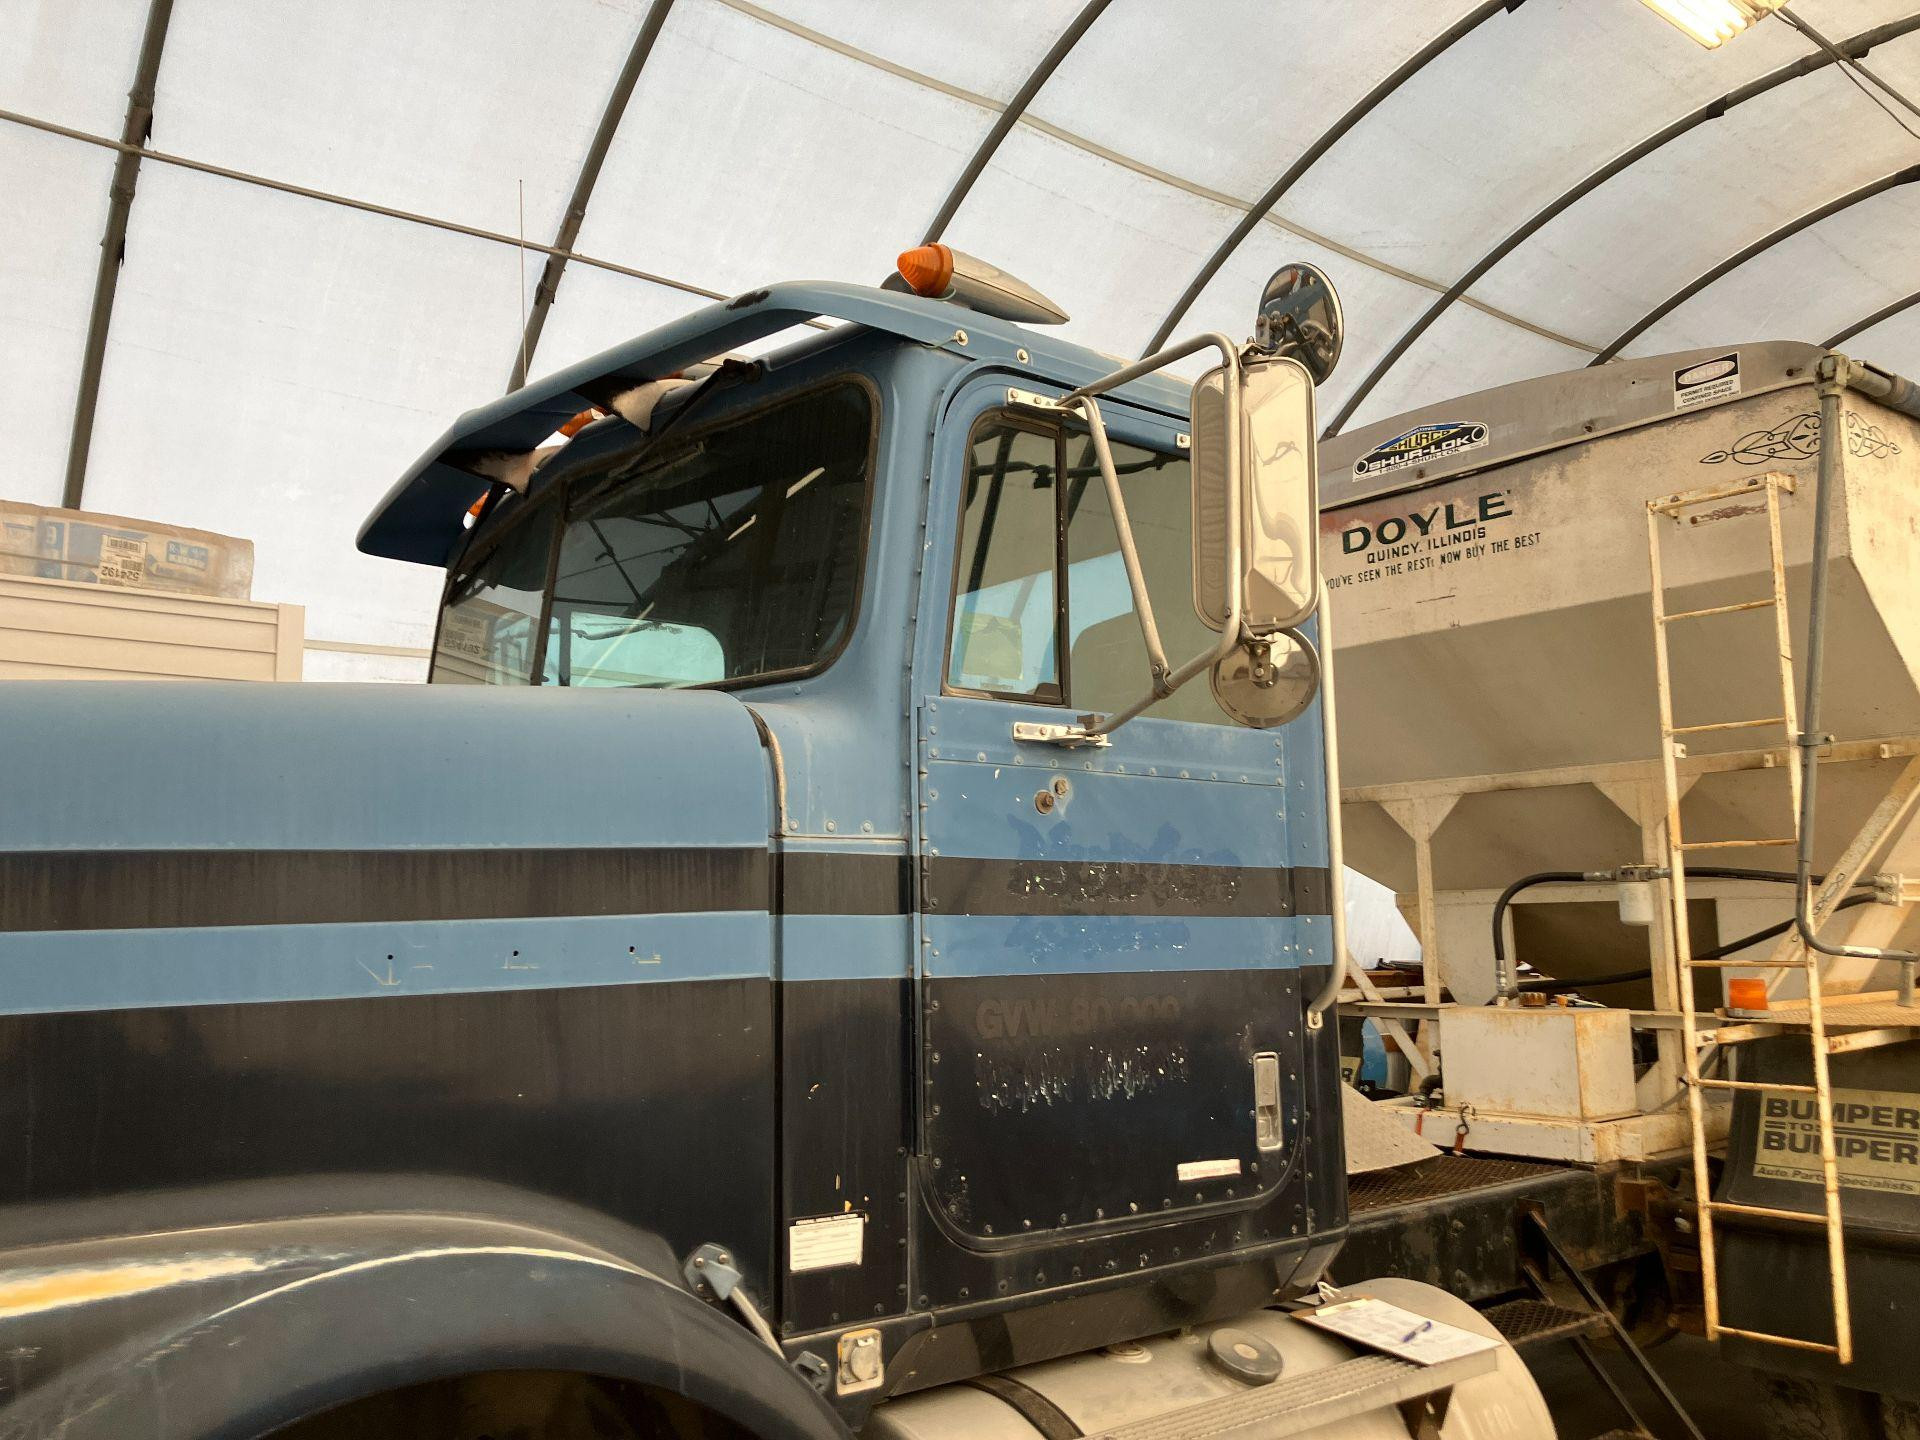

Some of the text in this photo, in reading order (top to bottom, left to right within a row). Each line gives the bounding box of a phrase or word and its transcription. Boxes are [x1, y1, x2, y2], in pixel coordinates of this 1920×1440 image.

[1684, 363, 1730, 382] DANGER
[1681, 379, 1734, 398] PERMIT REQUIRED
[1682, 386, 1733, 404] CONFINED SPACE
[1368, 434, 1471, 471] SHUR-LOK
[1342, 493, 1513, 554] DOYLE
[1428, 527, 1486, 550] ILLINOIS
[1358, 568, 1381, 583] SEEN
[1385, 563, 1402, 576] THE
[1440, 550, 1461, 565] NOW
[1466, 545, 1485, 559] BUY
[1491, 540, 1510, 553] THE
[1515, 532, 1541, 548] BEST
[1766, 1098, 1920, 1129] BUMPER
[1788, 1122, 1814, 1132] TO
[1763, 1131, 1919, 1165] BUMPER
[1758, 1166, 1787, 1177] Auto
[1837, 1174, 1914, 1192] Specialists
